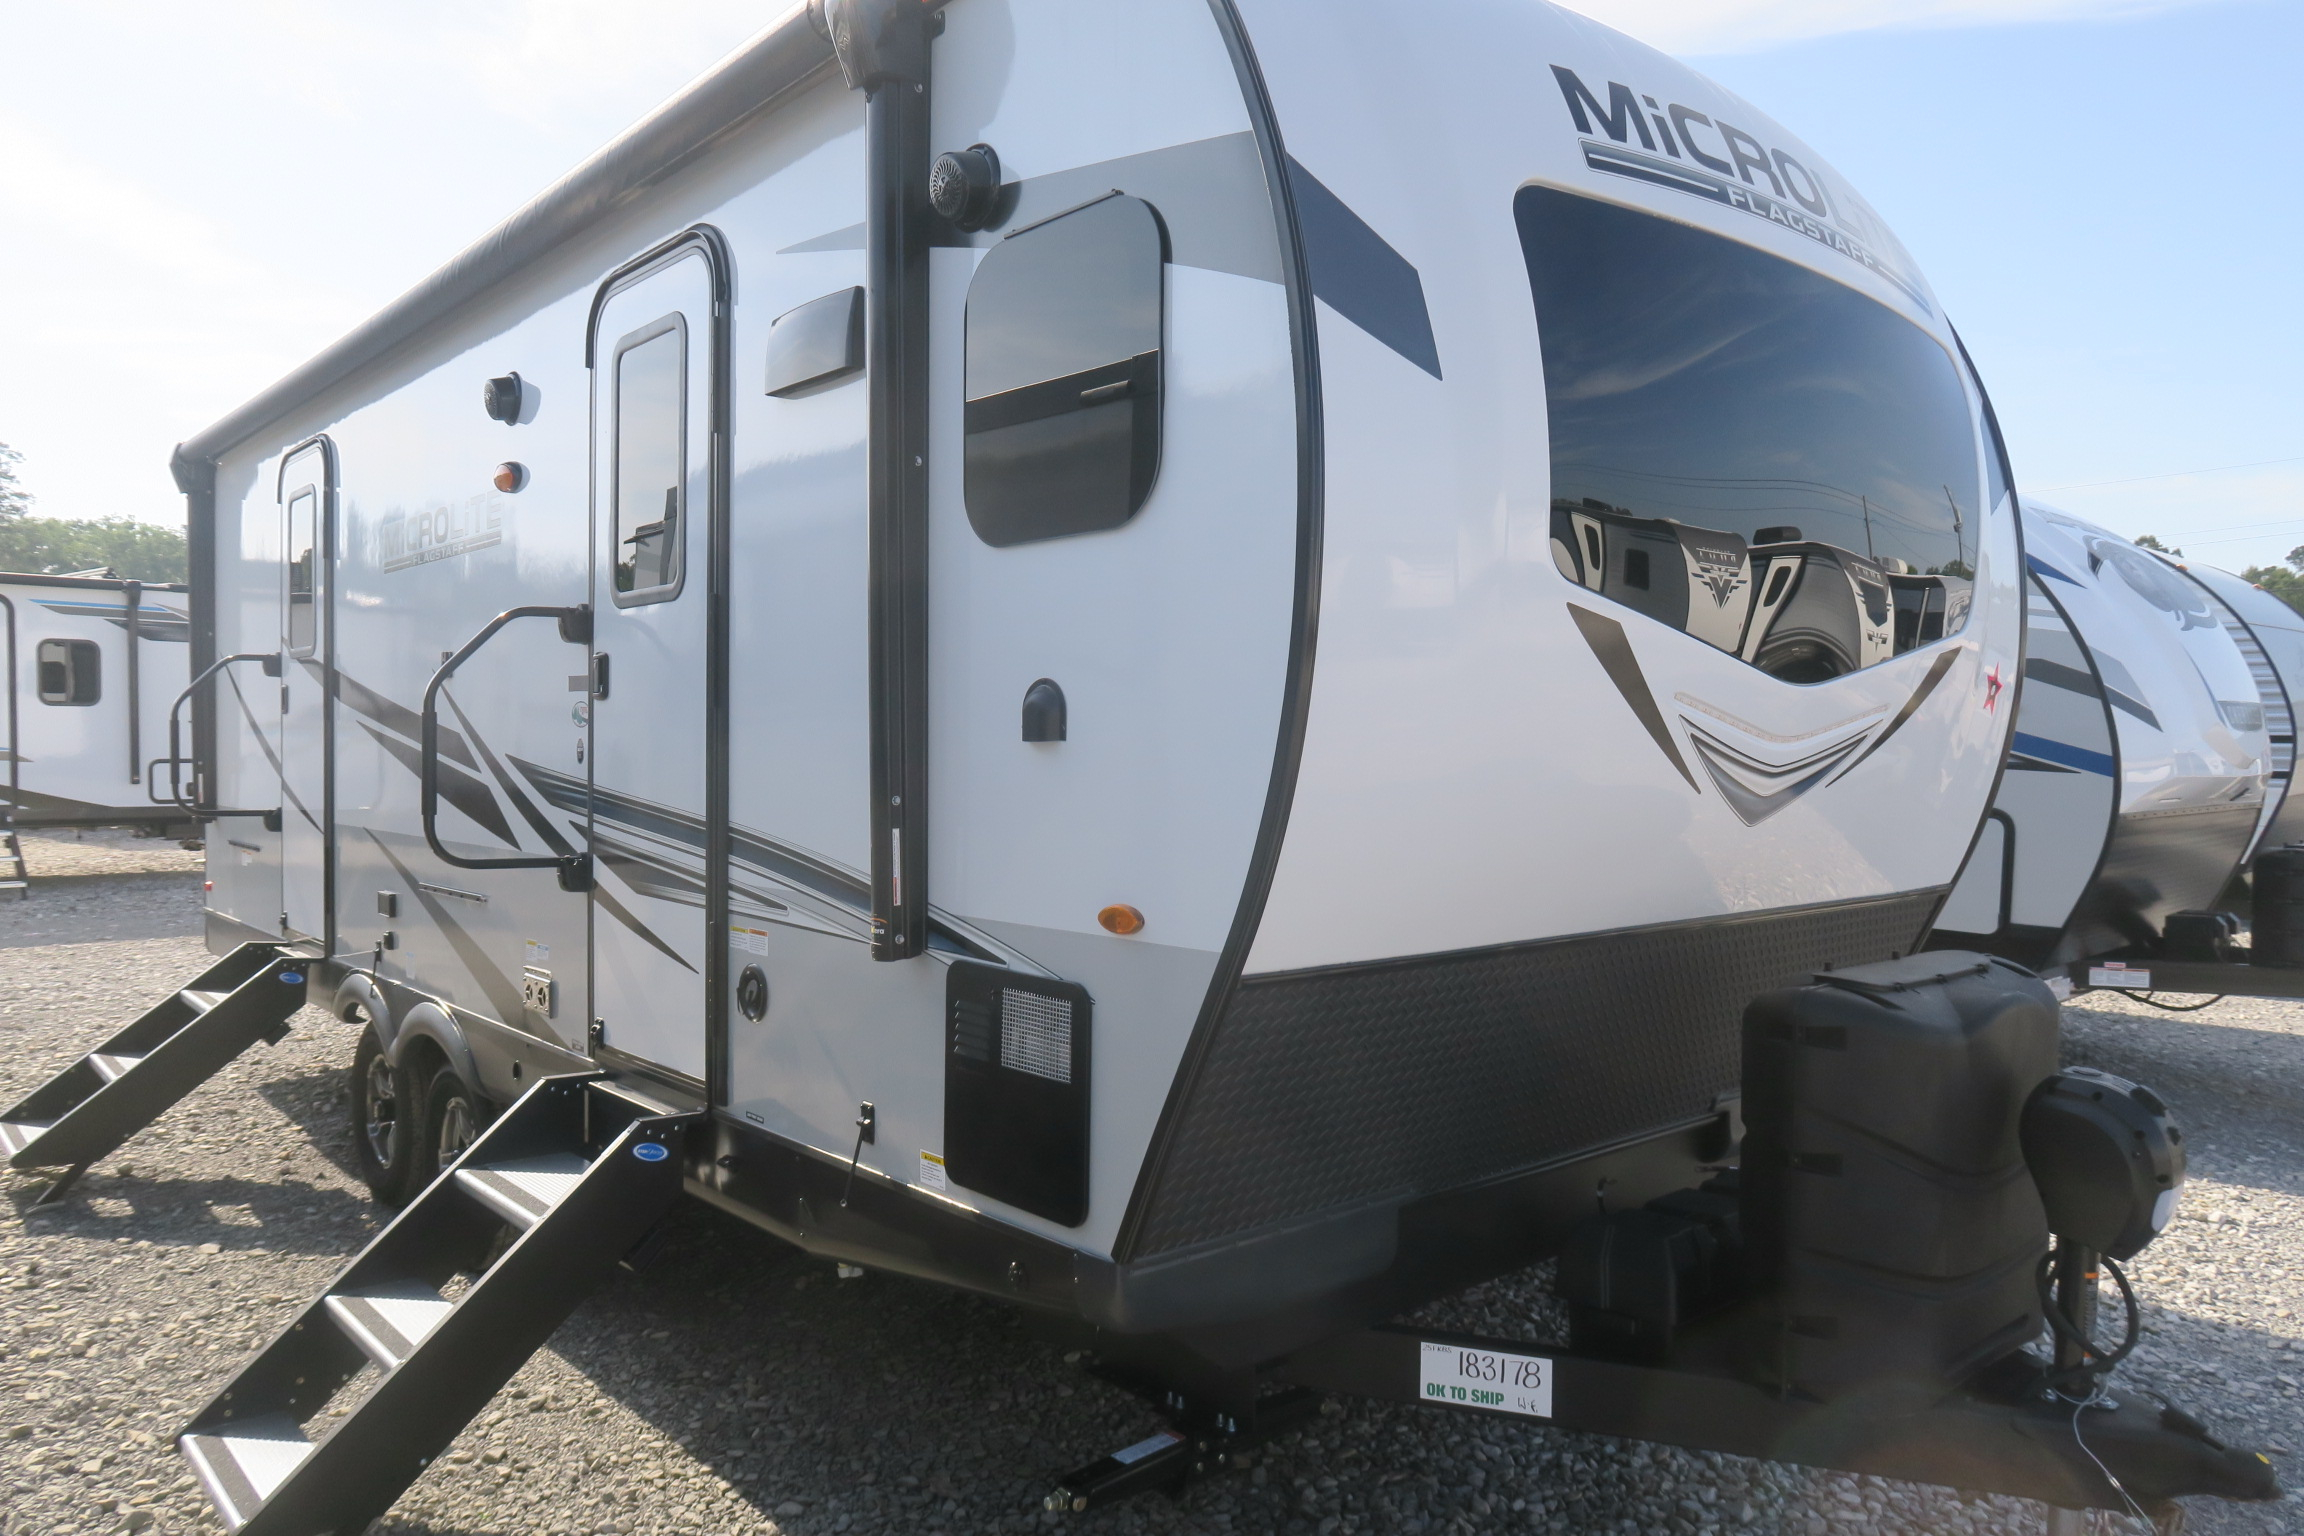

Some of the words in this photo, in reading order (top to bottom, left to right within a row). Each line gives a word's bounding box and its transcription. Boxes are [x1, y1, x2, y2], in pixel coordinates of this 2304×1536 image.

[1549, 64, 1900, 262] MiCROL
[1726, 186, 1878, 268] FLAGSTAFF
[411, 543, 464, 566] FLAGSTAFF
[1459, 1350, 1542, 1389] 183178
[1426, 1382, 1447, 1398] OK
[1450, 1386, 1467, 1401] TO
[1471, 1389, 1505, 1406] SHIP
